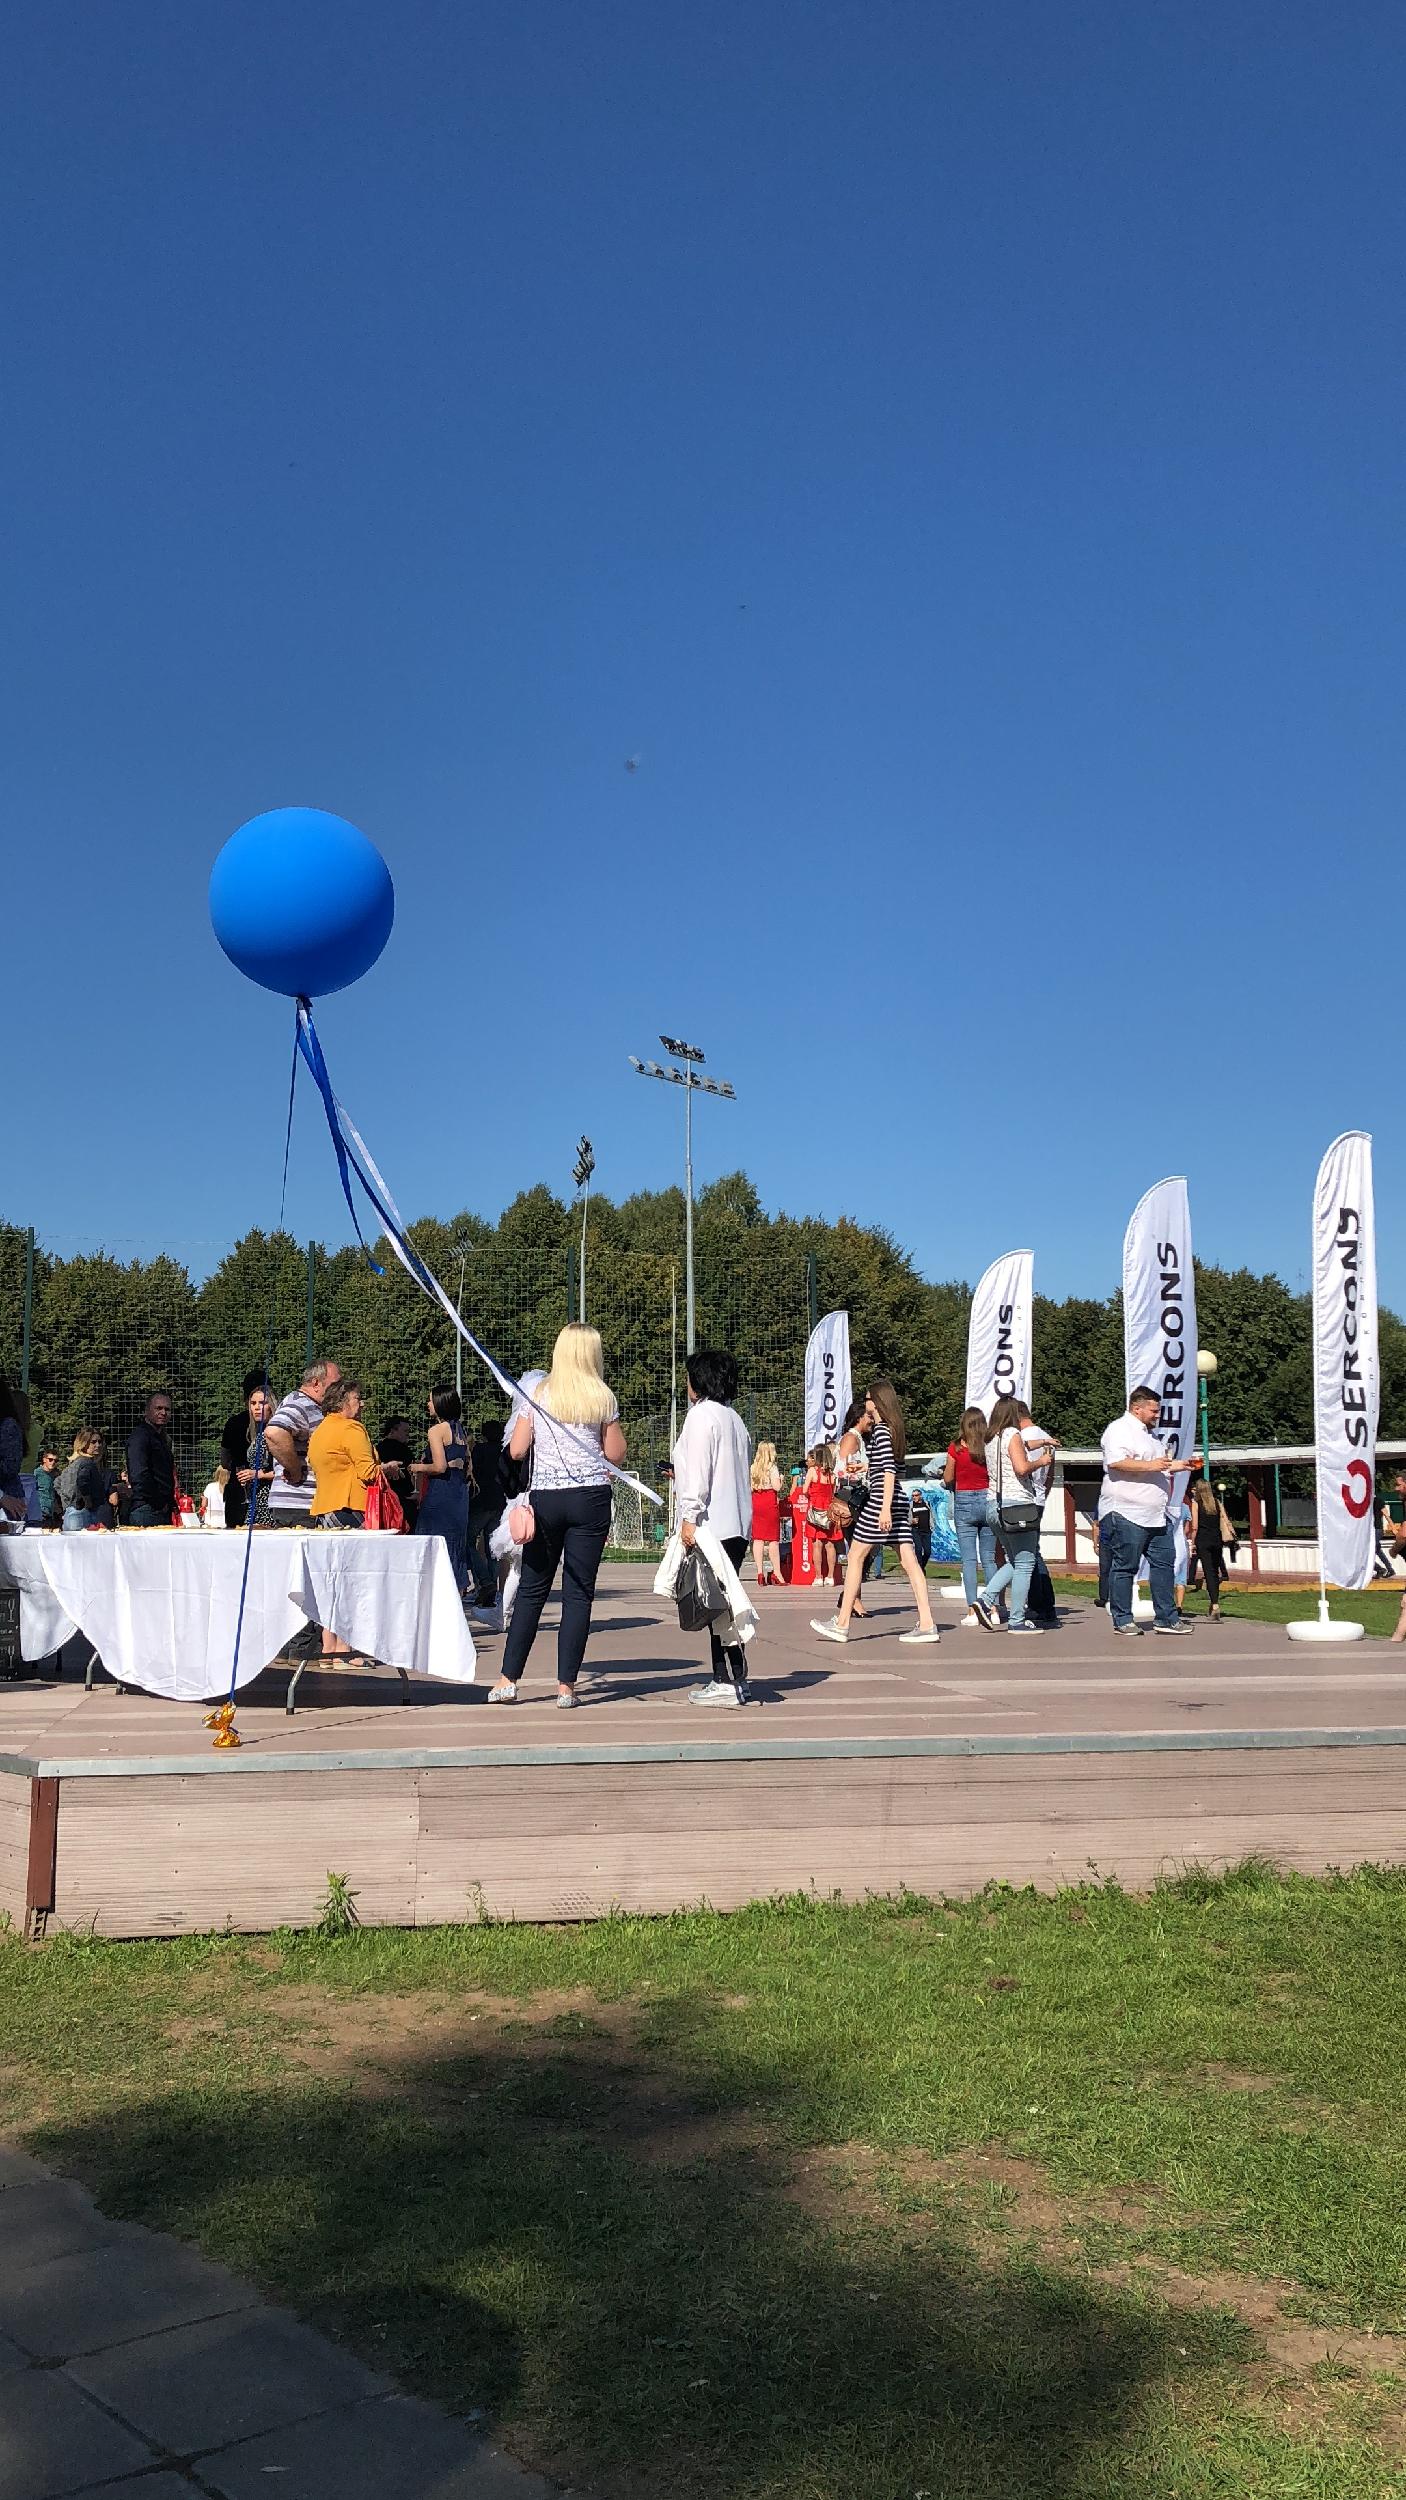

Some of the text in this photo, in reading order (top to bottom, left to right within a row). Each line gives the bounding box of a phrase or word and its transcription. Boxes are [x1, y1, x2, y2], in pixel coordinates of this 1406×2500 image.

[994, 1304, 1016, 1399] CONS
[1338, 1207, 1368, 1448] SERCONS
[822, 1352, 837, 1445] RCONS
